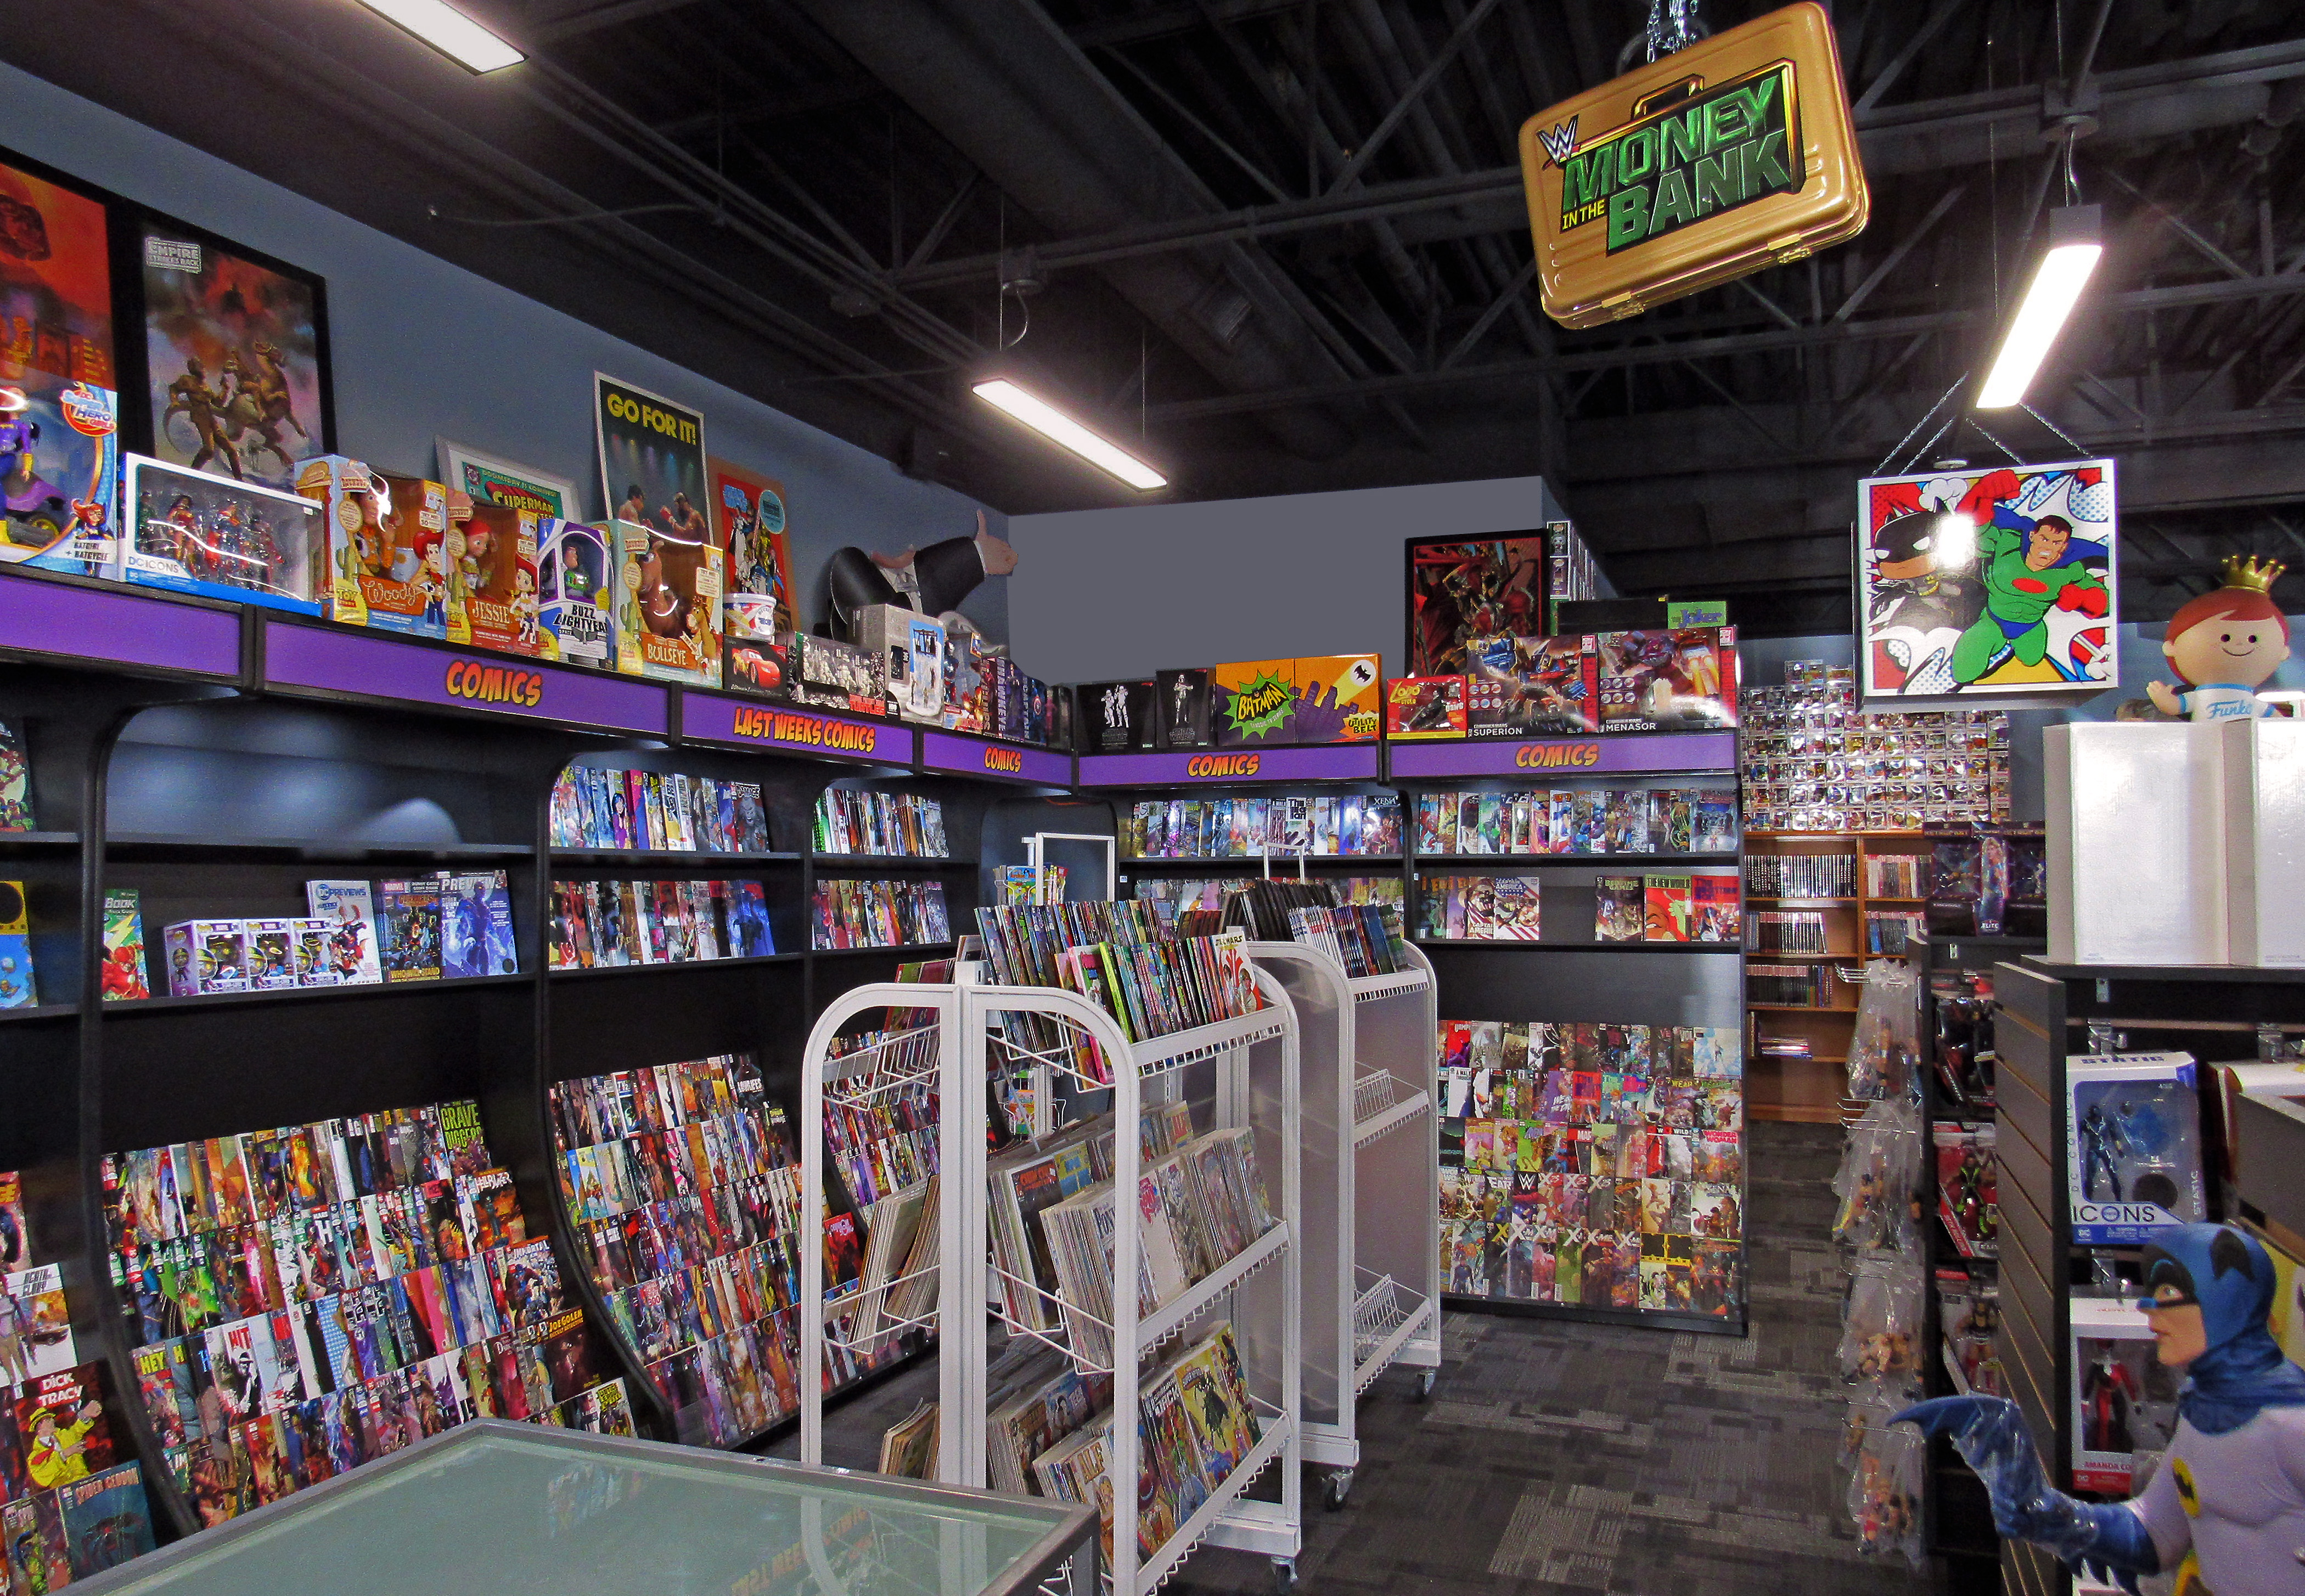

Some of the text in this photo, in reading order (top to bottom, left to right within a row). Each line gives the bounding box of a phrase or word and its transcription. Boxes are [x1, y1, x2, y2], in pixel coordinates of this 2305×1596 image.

[1563, 75, 1778, 213] MONEY
[1607, 128, 1791, 250] BANK
[1562, 201, 1605, 231] IN THE
[74, 404, 113, 421] HERO
[607, 393, 696, 445] GO FOR IT!
[363, 580, 418, 606] Woody
[473, 601, 511, 624] JESSIE
[572, 604, 596, 619] BUZZ
[648, 643, 687, 666] BULLSEYE
[446, 659, 542, 707] COMICS
[849, 700, 886, 716] TURTLES
[1238, 683, 1288, 720] BATMAN
[734, 708, 875, 753] LAST WEEKS COMICS
[1348, 717, 1377, 727] UTILITY
[1353, 725, 1377, 735] BELT
[1474, 727, 1523, 736] SUPERION
[1606, 722, 1656, 732] MENASOR
[984, 747, 1021, 772] COMICS
[1187, 754, 1260, 777] COMICS
[1516, 744, 1599, 768] COMICS
[1228, 934, 1243, 944] WARS
[440, 1103, 481, 1131] GRAVE
[2072, 1204, 2156, 1223] ICONS
[549, 1308, 583, 1333] JOE GOLEM
[228, 1326, 252, 1351] HIT
[38, 1385, 85, 1406] TRACY
[1076, 1442, 1105, 1485] ALF
